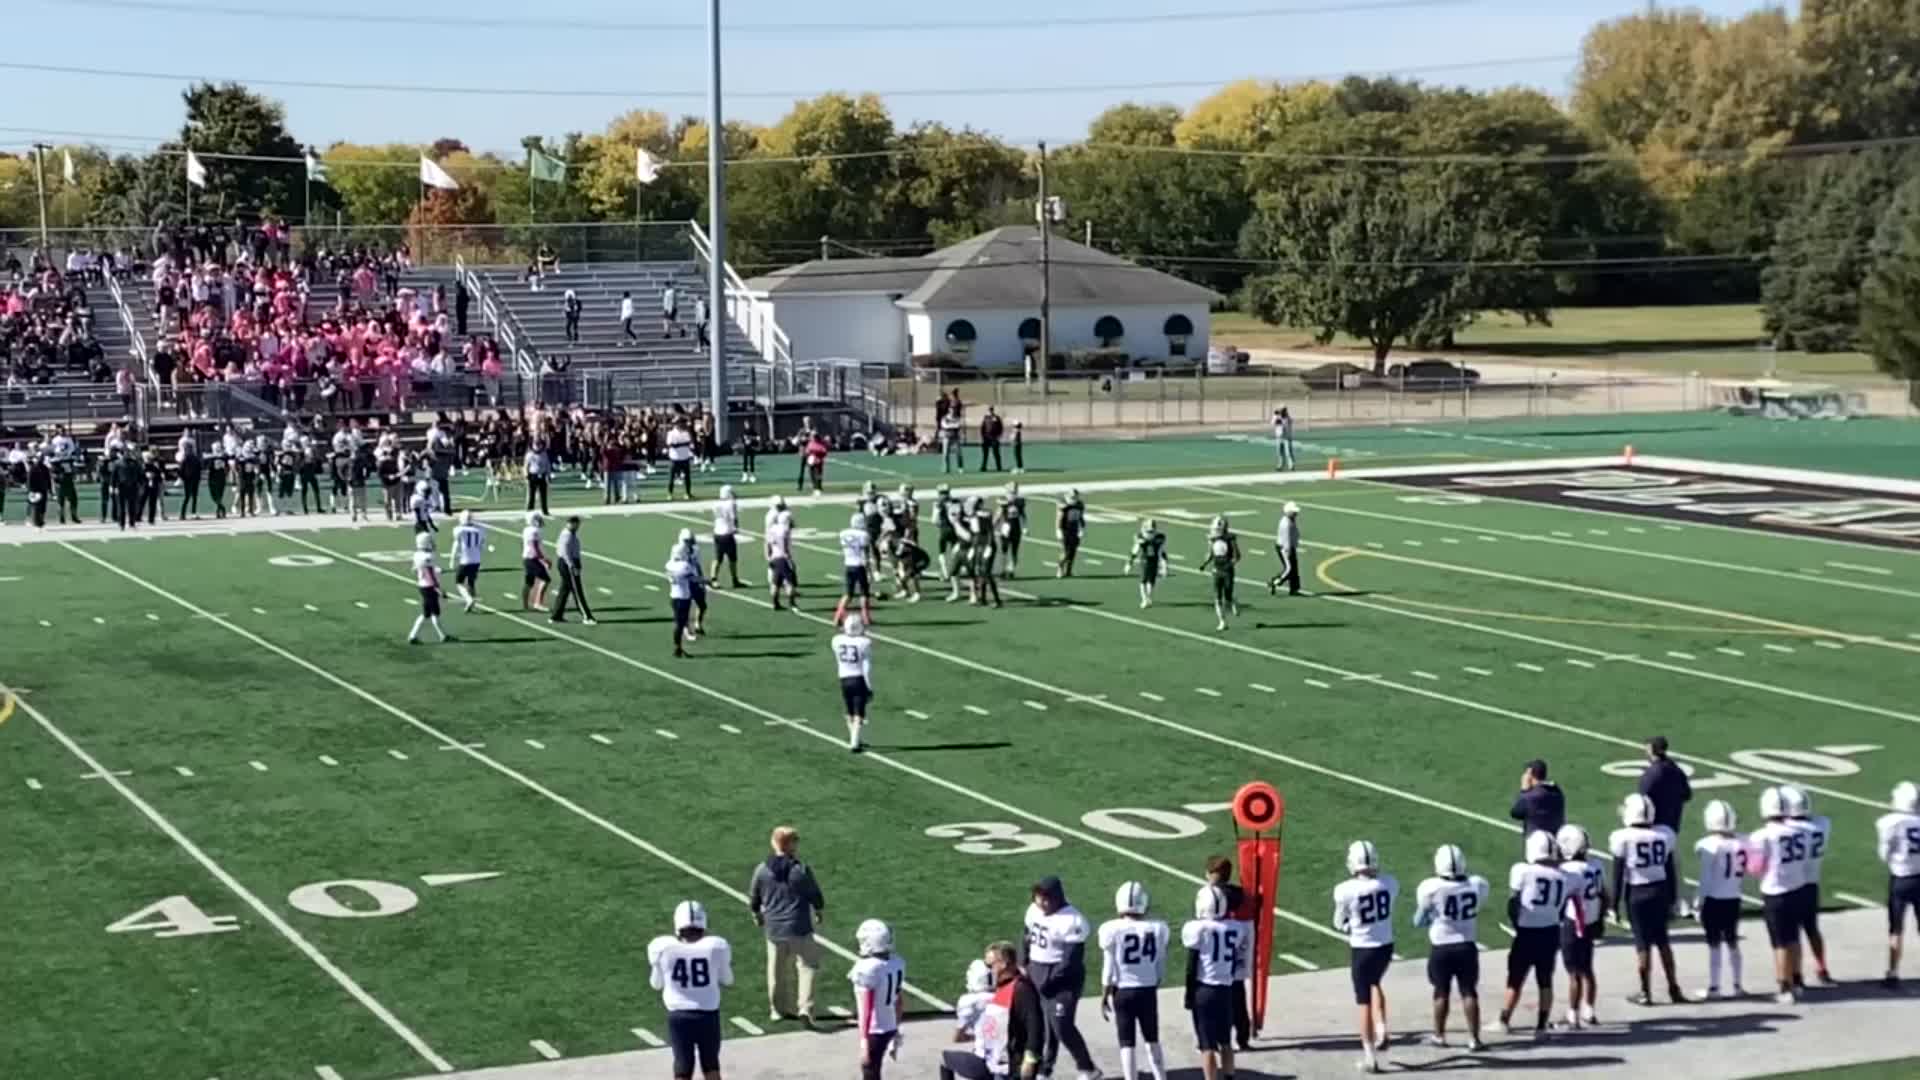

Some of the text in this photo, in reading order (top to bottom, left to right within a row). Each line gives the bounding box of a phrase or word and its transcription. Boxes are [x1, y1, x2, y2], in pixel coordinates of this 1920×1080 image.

[925, 808, 1206, 854] 30
[1635, 840, 1666, 868] 58
[1779, 832, 1806, 863] 35
[1725, 849, 1747, 879] 13
[1358, 890, 1390, 924] 28
[1444, 892, 1478, 920] 42
[1531, 877, 1563, 907] 31
[105, 880, 418, 937] 40
[1123, 932, 1158, 964] 24
[1212, 929, 1238, 962] 15
[671, 957, 711, 988] 48
